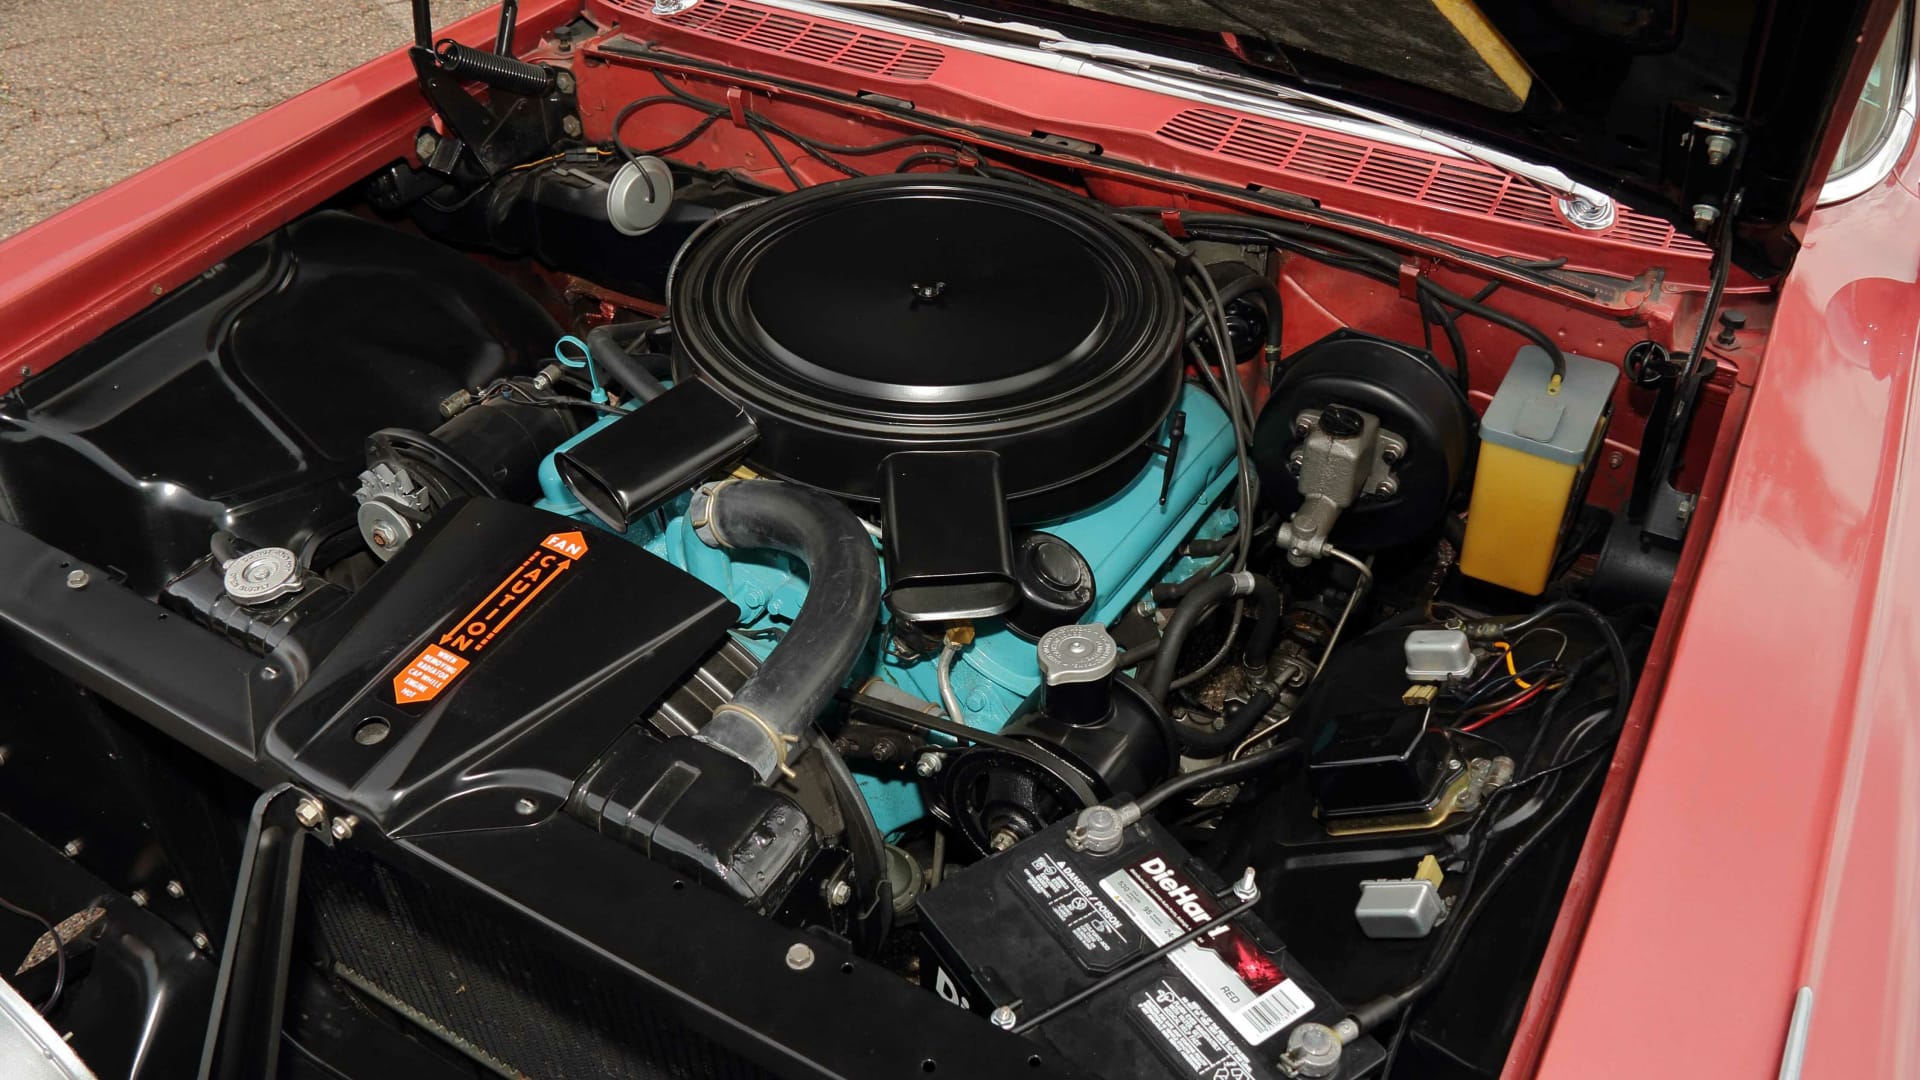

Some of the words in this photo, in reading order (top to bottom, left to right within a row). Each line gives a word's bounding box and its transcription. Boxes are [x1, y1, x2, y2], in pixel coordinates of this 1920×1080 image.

[547, 536, 582, 555] FAN
[450, 555, 557, 651] CAUTION
[423, 654, 457, 674] REMOVING
[437, 650, 458, 664] WHEN
[407, 668, 423, 678] CAP
[421, 674, 443, 688] WHILE
[416, 661, 449, 680] RADIATOR
[400, 687, 417, 698] HOT
[403, 677, 429, 693] ENGINE
[1062, 866, 1093, 897] DANGER
[1094, 900, 1123, 929] POISON
[1220, 985, 1241, 1004] RED
